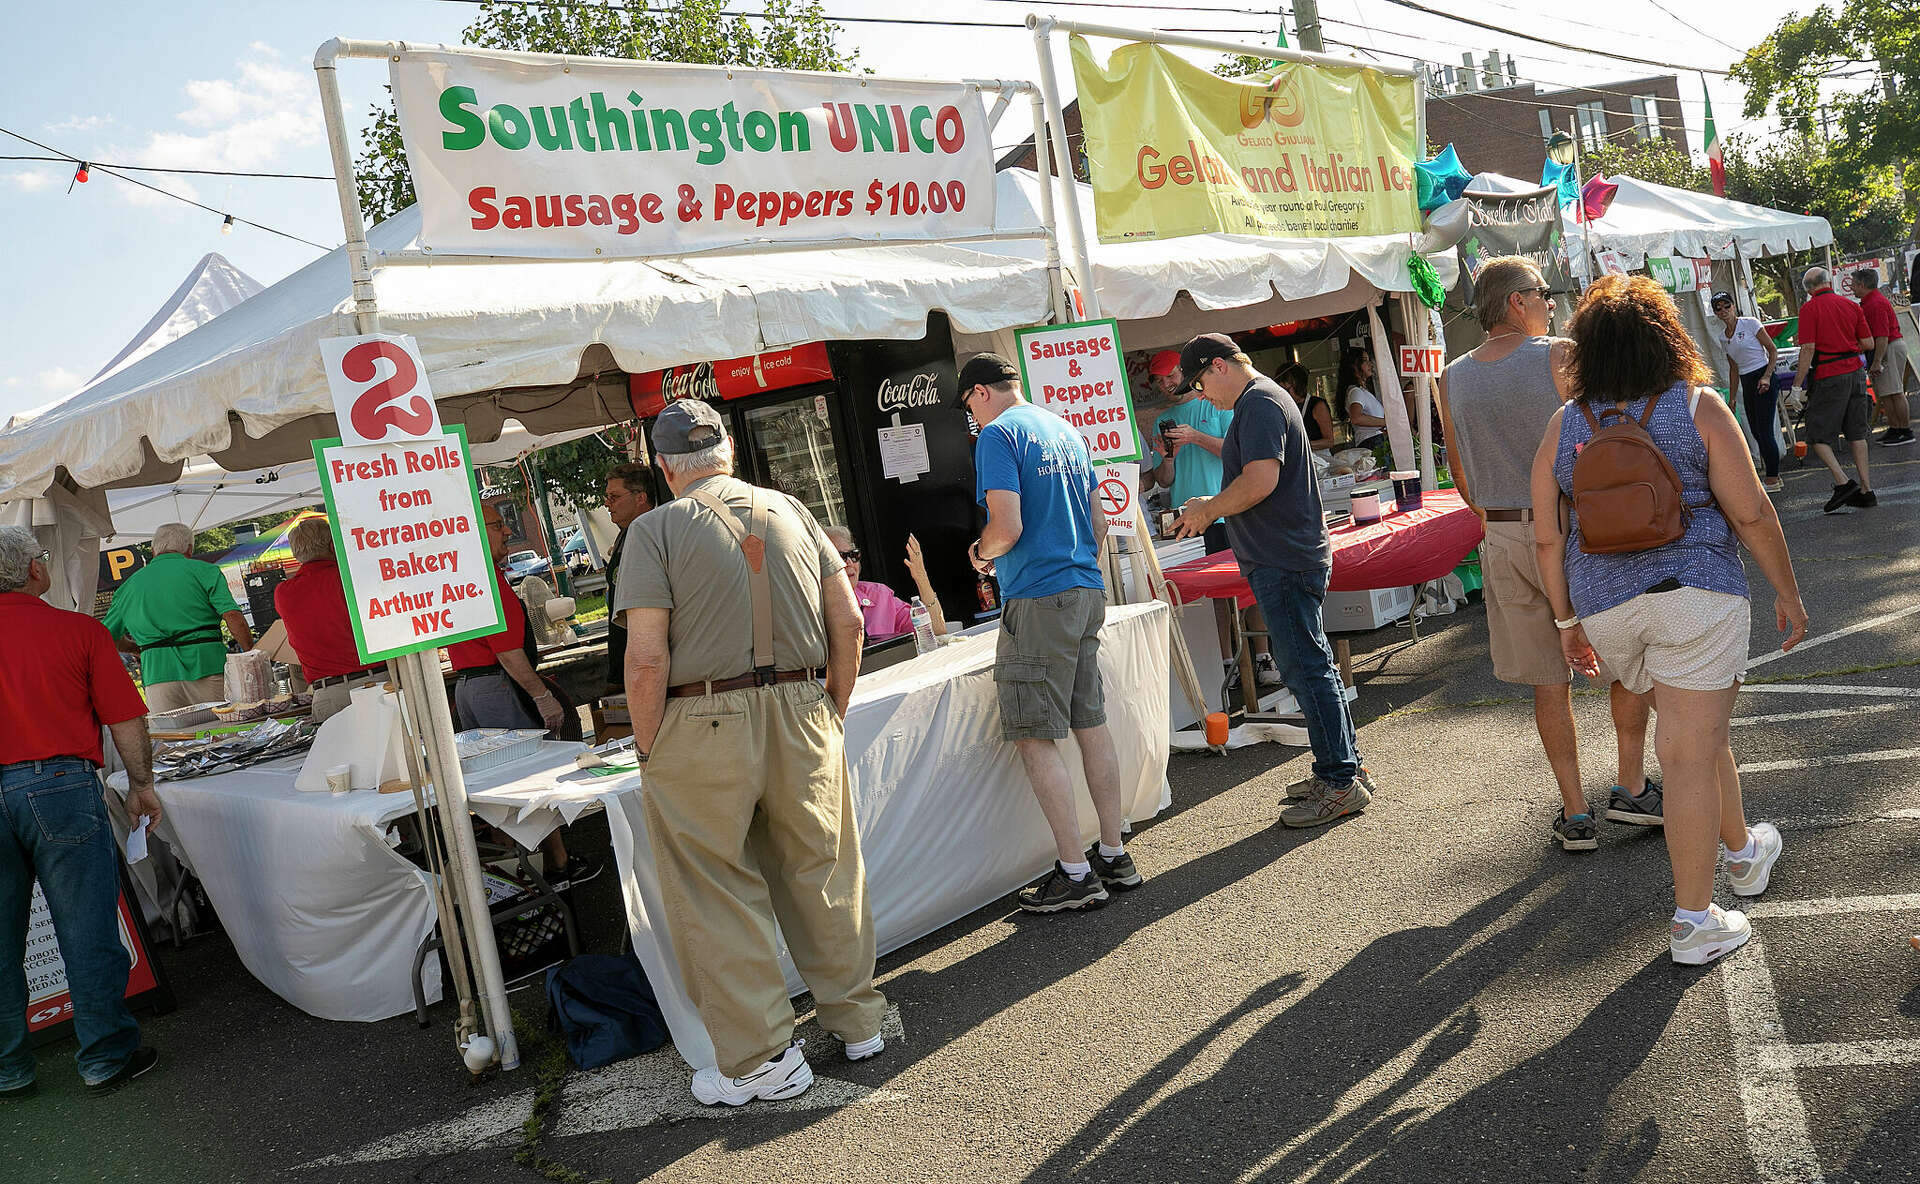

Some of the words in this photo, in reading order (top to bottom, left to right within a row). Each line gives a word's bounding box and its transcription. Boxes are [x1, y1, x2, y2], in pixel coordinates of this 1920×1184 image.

[438, 86, 811, 166] Southington
[822, 101, 965, 154] UNICO
[1237, 132, 1272, 147] GELATO
[1274, 131, 1315, 146] GIULIANA
[1241, 153, 1298, 193] and
[1301, 154, 1374, 193] Italian
[469, 186, 664, 235] Sausage
[677, 184, 705, 222] &
[713, 183, 854, 227] Peppers
[864, 179, 966, 216] $10.00
[1327, 200, 1365, 214] Gregory's
[1329, 219, 1359, 232] charities
[1029, 336, 1112, 361] Sausage
[731, 366, 751, 378] enjoy
[763, 360, 774, 370] ice
[775, 355, 792, 368] cold
[1068, 359, 1083, 378] &
[1402, 349, 1442, 373] EXIT
[341, 341, 434, 441] 2
[662, 361, 721, 406] Coca-Cola
[1043, 379, 1114, 404] Pepper
[1061, 406, 1126, 428] inders
[1084, 431, 1121, 453] .00
[331, 453, 397, 484] Fresh
[404, 446, 461, 474] Rolls
[1106, 468, 1121, 478] No
[379, 487, 432, 512] from
[350, 514, 470, 551] Terranova
[1107, 517, 1132, 529] oking
[378, 550, 459, 582] Bakery
[368, 589, 435, 620] Arthur
[441, 582, 484, 605] Ave.
[411, 609, 454, 637] NYC
[35, 919, 54, 929] SER
[23, 947, 59, 963] ROBOTI
[27, 977, 38, 986] OP
[39, 973, 50, 983] 25
[51, 967, 65, 978] AW
